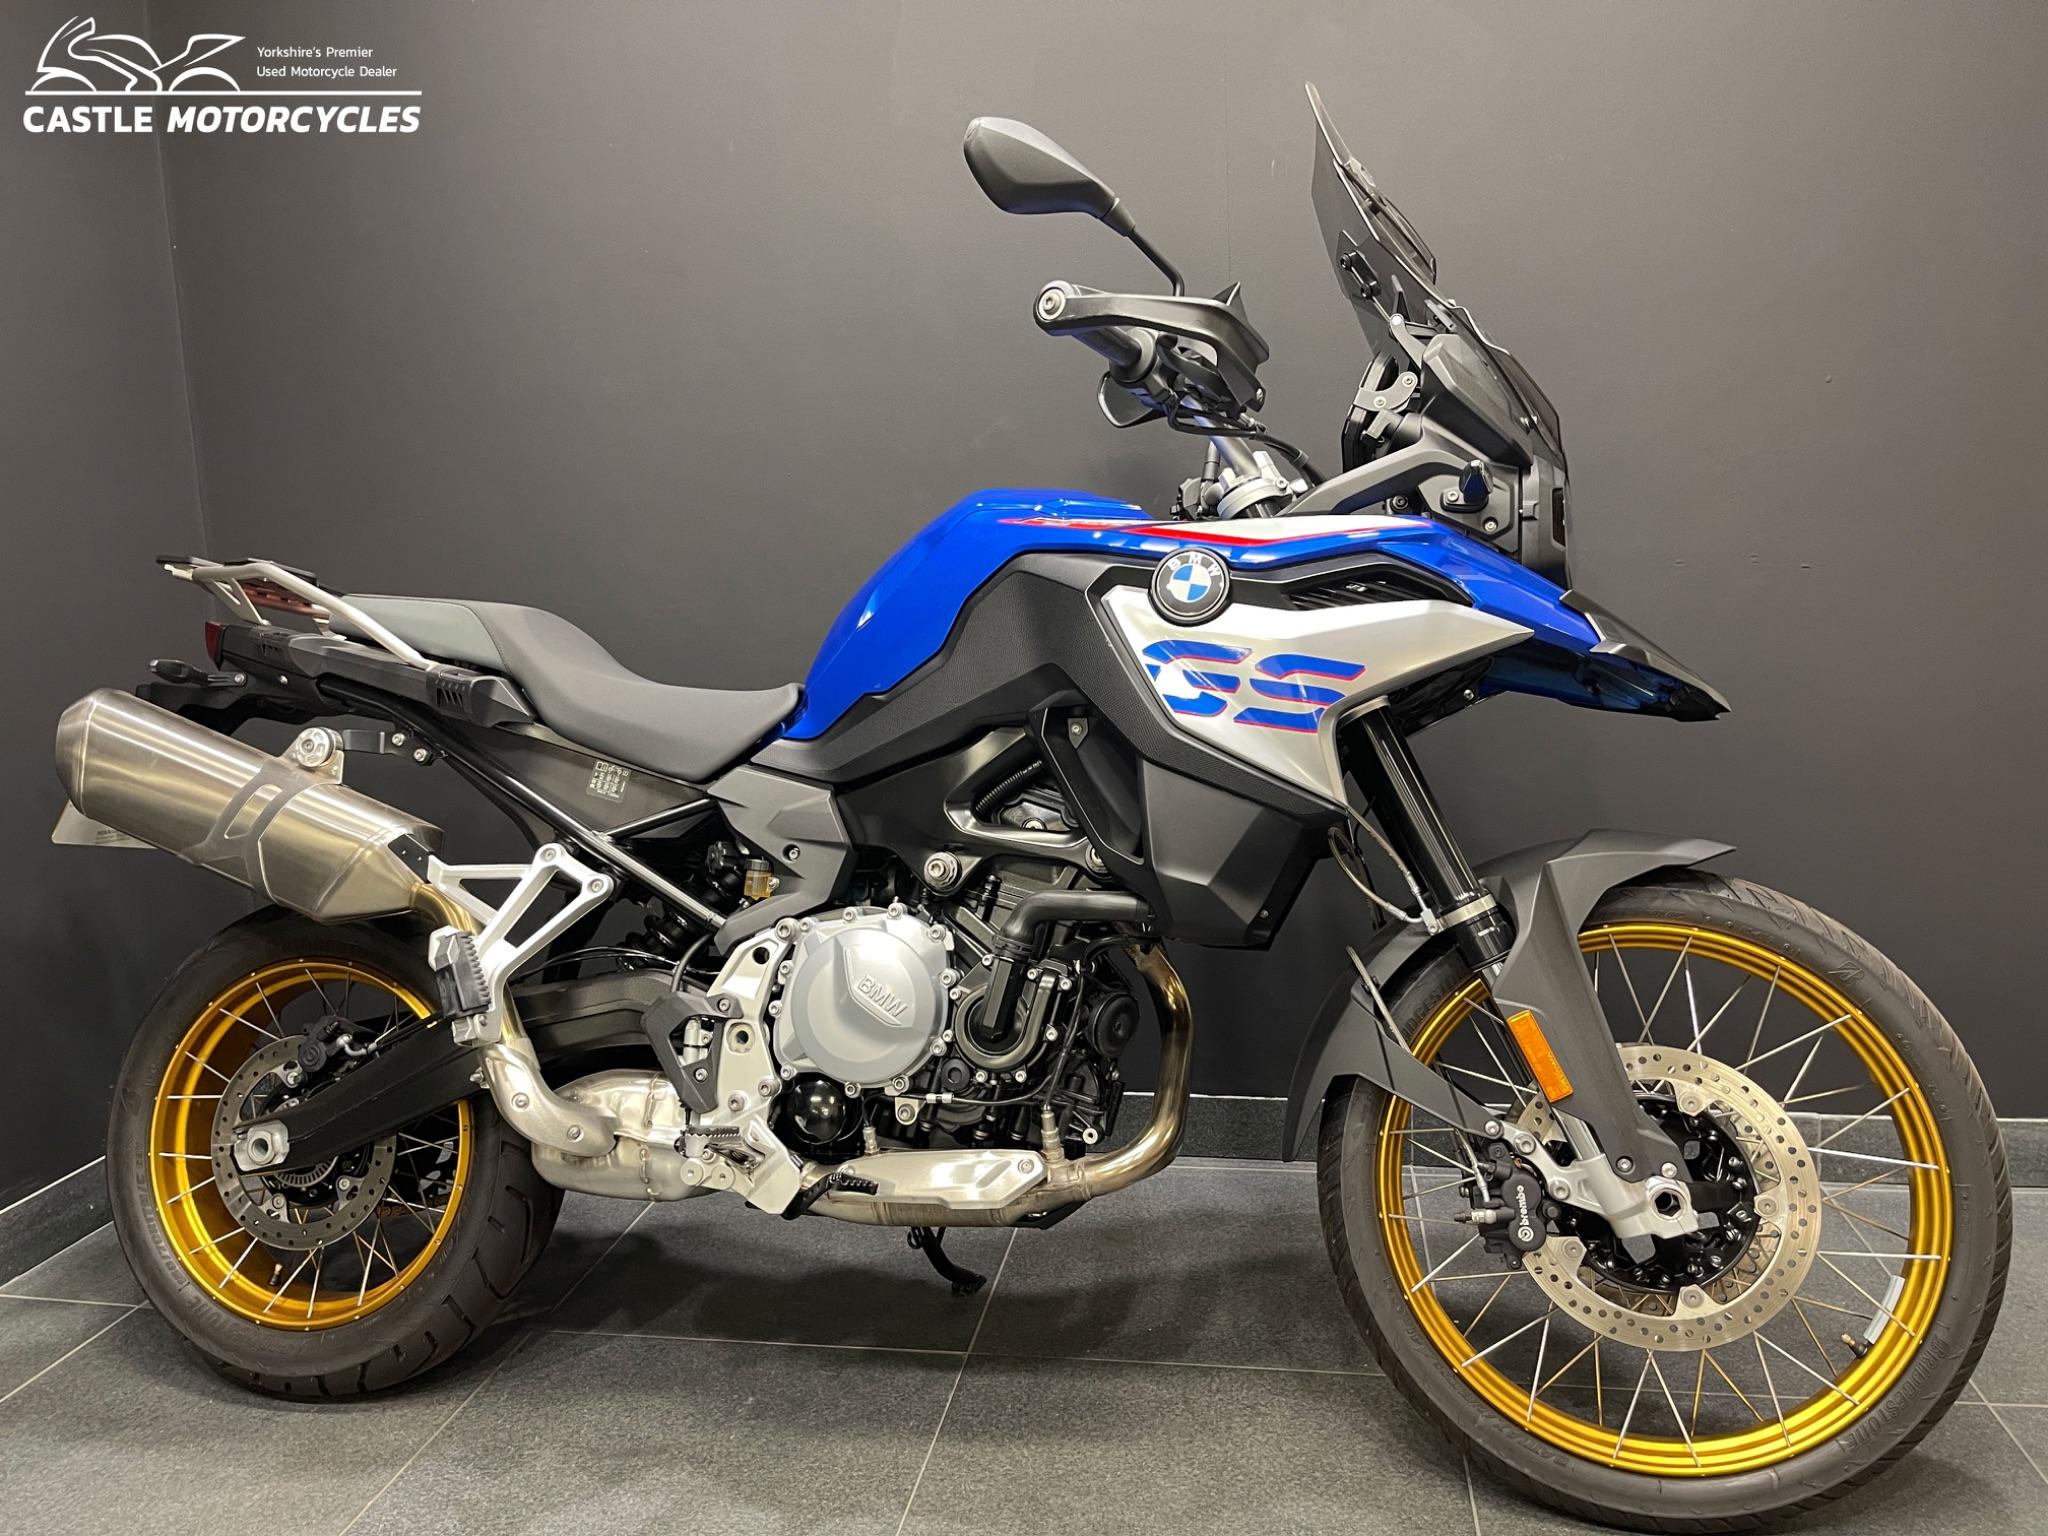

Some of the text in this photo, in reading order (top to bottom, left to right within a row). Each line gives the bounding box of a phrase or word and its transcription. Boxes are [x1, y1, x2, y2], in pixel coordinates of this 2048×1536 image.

[1143, 640, 1366, 734] GS
[857, 974, 908, 1018] BMW
[1515, 1184, 1530, 1226] brembo
[1848, 1334, 1950, 1450] BRIDGESTONE
